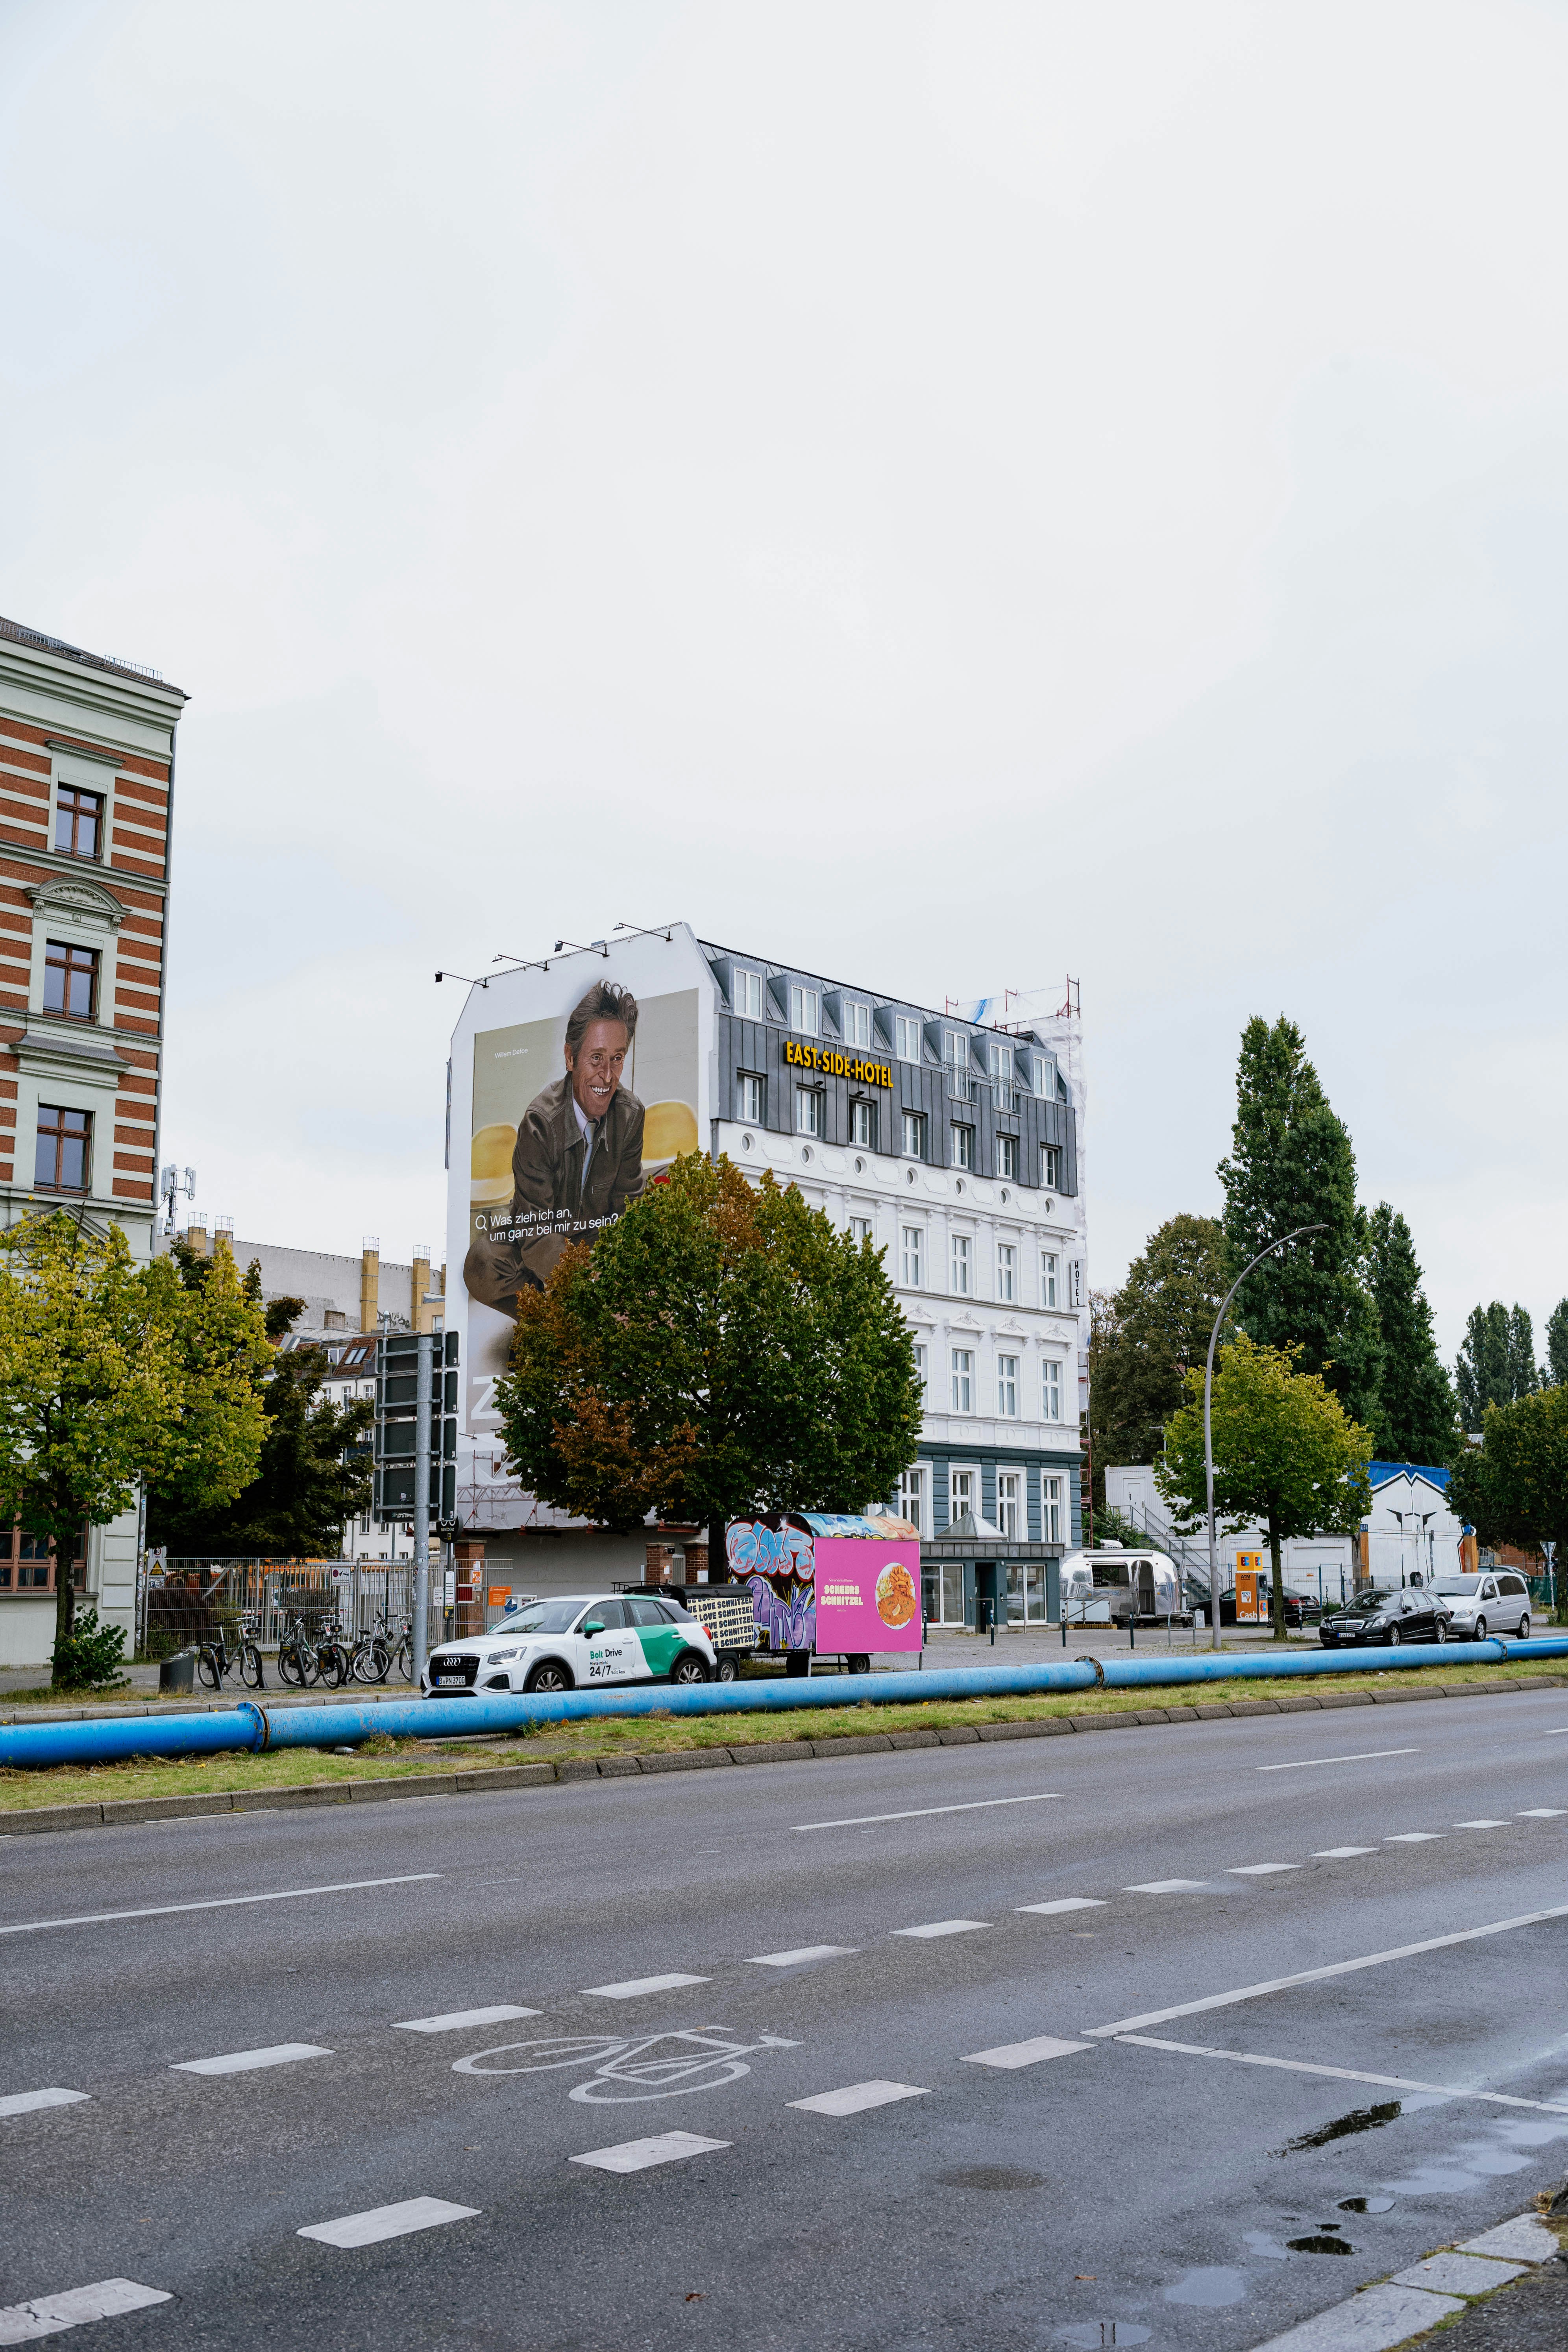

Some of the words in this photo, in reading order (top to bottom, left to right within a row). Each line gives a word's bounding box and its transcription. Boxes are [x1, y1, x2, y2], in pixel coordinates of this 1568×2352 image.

[786, 1041, 894, 1088] EAST-SIDE-HOTEL
[490, 1215, 512, 1227] Was
[516, 1211, 536, 1224] zieh
[539, 1208, 554, 1221] ich
[557, 1209, 572, 1218] an,
[490, 1231, 506, 1242] um
[508, 1228, 534, 1242] ganz
[536, 1222, 551, 1235] bei
[555, 1220, 570, 1233] mir
[573, 1220, 586, 1230] zu
[589, 1213, 618, 1228] sein?
[824, 1585, 860, 1595] SCHEERS
[699, 1602, 716, 1612] LOVE
[717, 1598, 752, 1609] SCHNITZEL
[821, 1596, 864, 1605] SCHNITZEL
[699, 1612, 716, 1622] LOVE
[718, 1606, 753, 1618] SCHNITZEL
[1240, 1611, 1257, 1619] Cash
[719, 1615, 753, 1628] SCHNITZEL
[720, 1625, 754, 1638] SCHNITZEL
[590, 1650, 603, 1659] Bolt
[605, 1648, 622, 1657] Drive
[590, 1665, 611, 1677] 24/7
